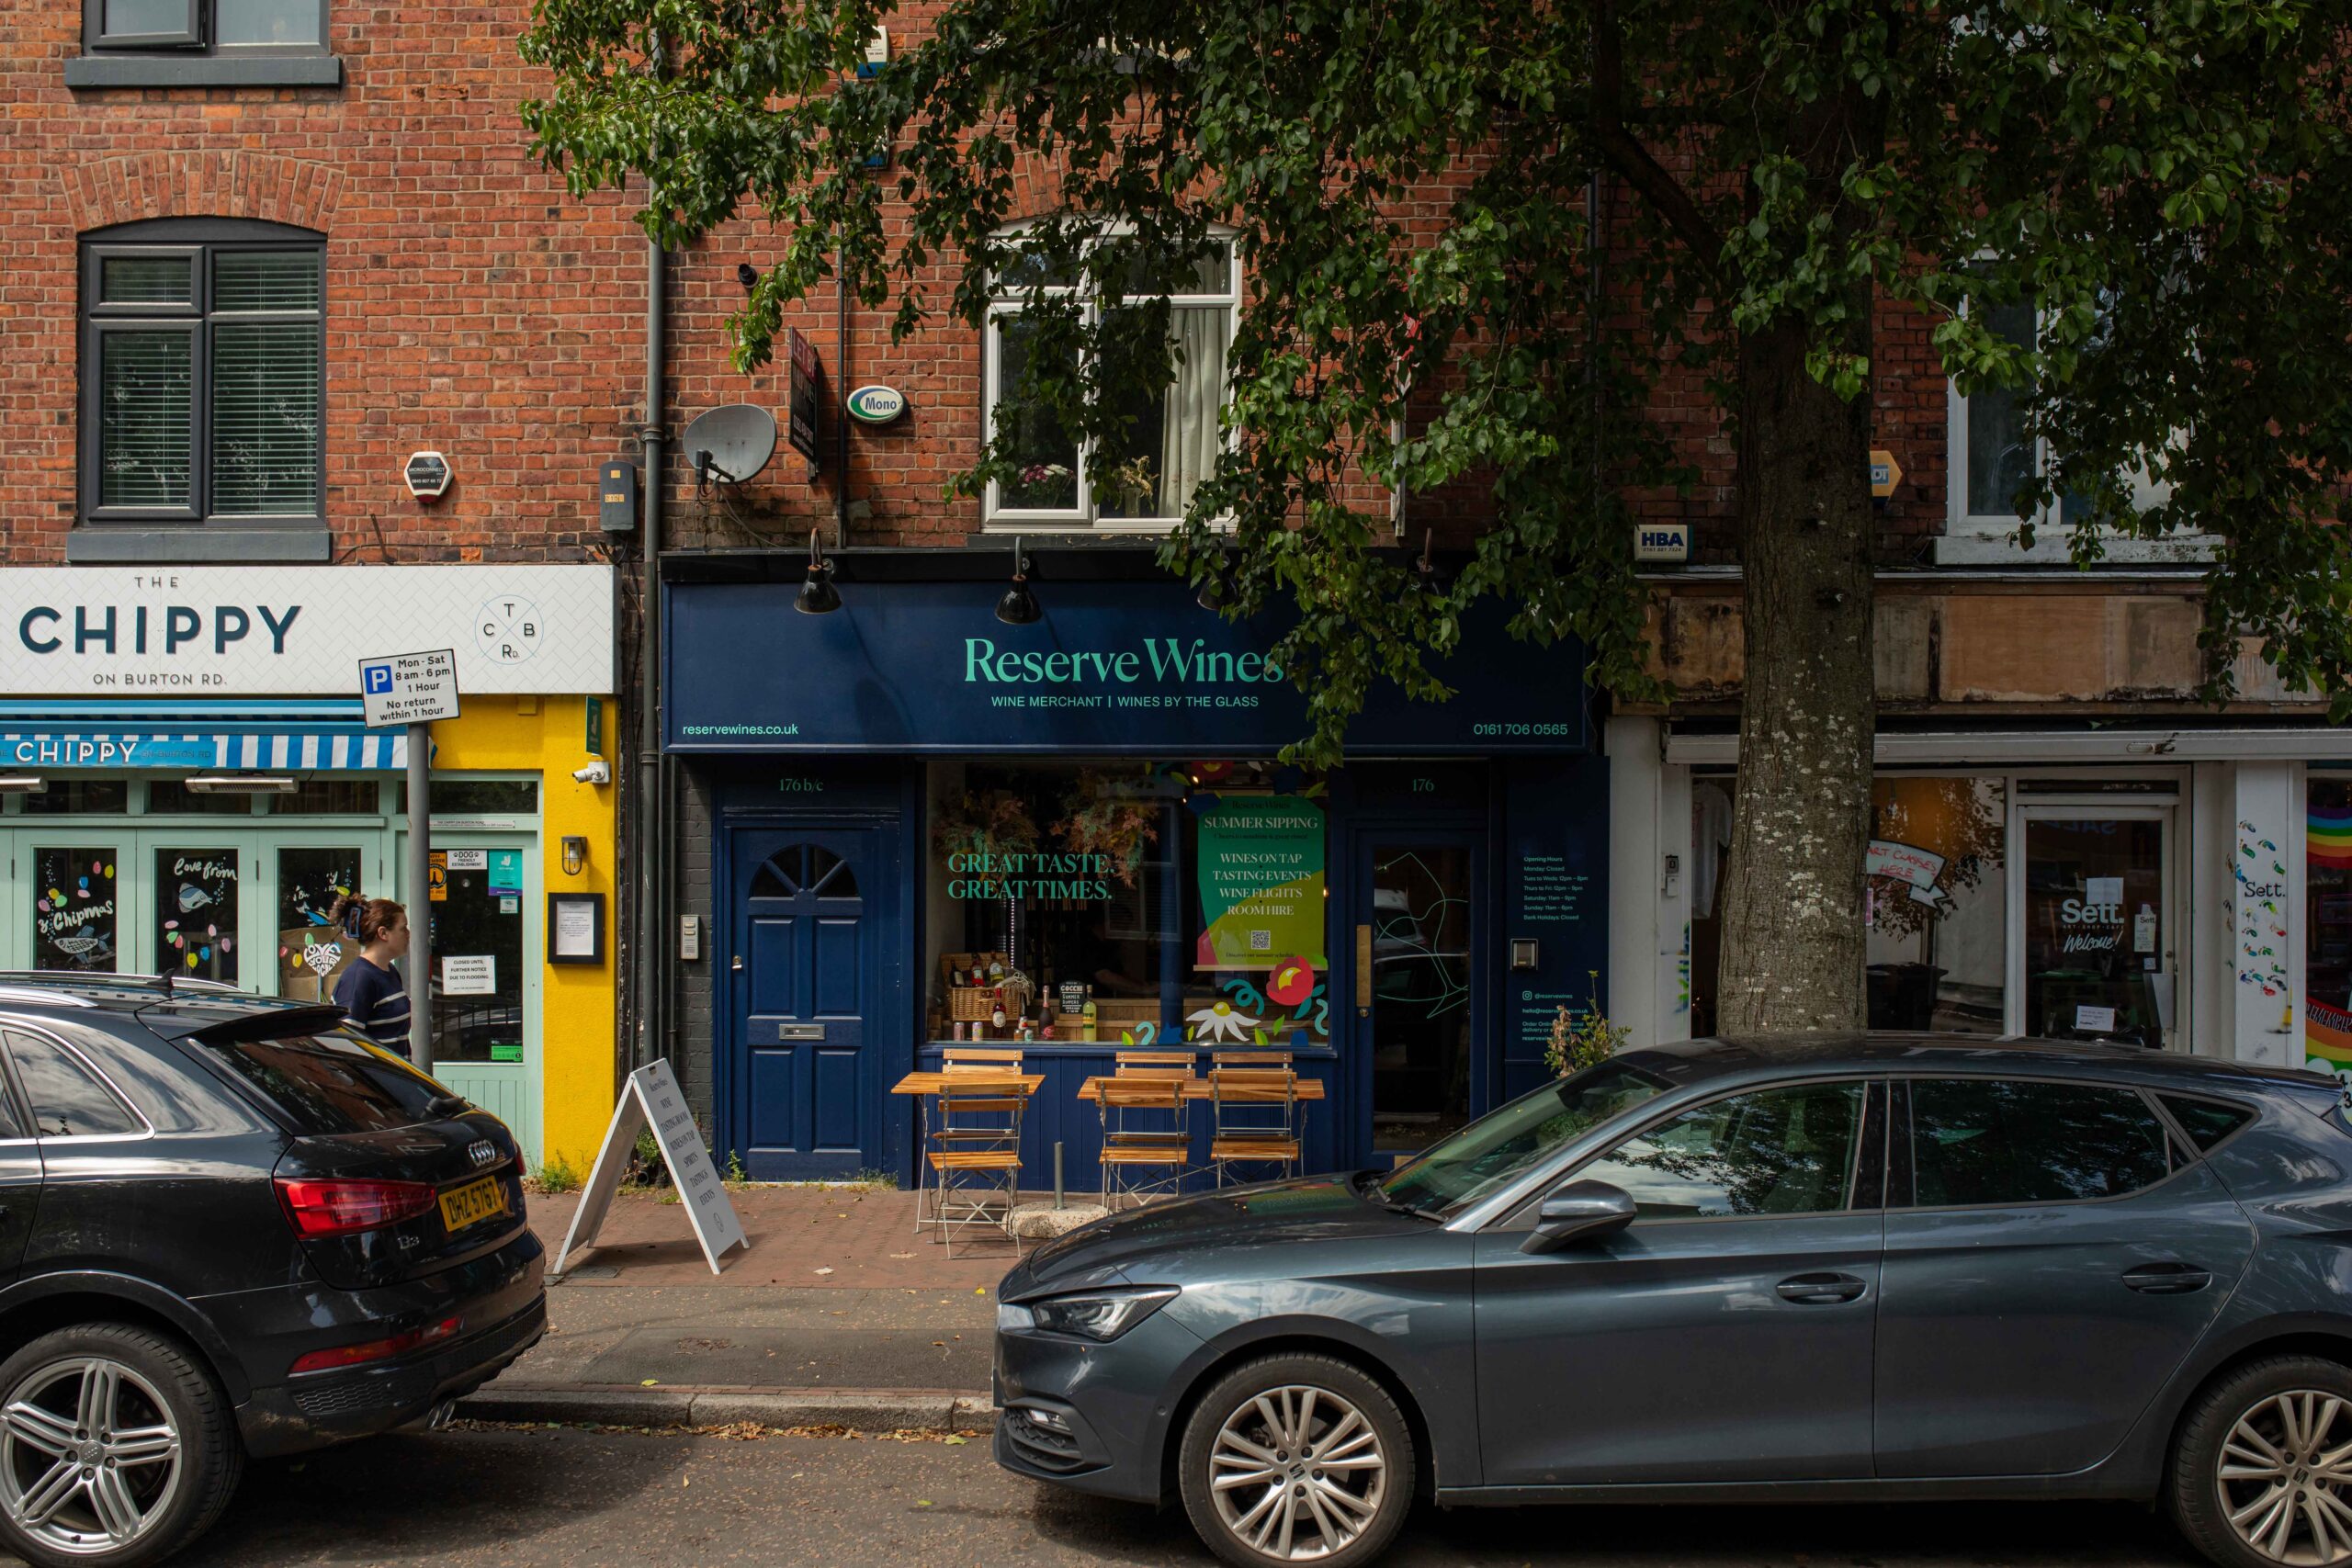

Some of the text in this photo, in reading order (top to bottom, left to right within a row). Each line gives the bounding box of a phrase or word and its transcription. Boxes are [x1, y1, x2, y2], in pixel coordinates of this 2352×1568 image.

[793, 332, 806, 365] LET
[865, 397, 898, 410] Mono
[1642, 532, 1684, 547] HBA
[134, 576, 179, 589] THE
[19, 605, 302, 654] CHIPPY
[398, 658, 420, 669] Mon
[427, 655, 446, 666] Sat
[965, 638, 1284, 682] Reserve Wines
[93, 673, 227, 685] ON BURTON RD.
[395, 672, 401, 681] 8
[426, 669, 433, 677] 6
[435, 668, 450, 678] pm
[407, 682, 440, 693] 1 Hour
[387, 697, 435, 709] No return
[991, 696, 1025, 707] WINE
[1029, 696, 1102, 707] MERCHANT
[1117, 696, 1160, 707] WINES
[1165, 696, 1182, 707] BY
[1186, 696, 1213, 707] THE
[1216, 696, 1259, 707] GLASS
[379, 710, 411, 721] within
[421, 706, 445, 716] hour
[683, 724, 798, 735] reservewines.co.uk
[1474, 724, 1568, 735] 0161 706 0565
[15, 741, 137, 763] CHIPPY
[780, 779, 824, 793] 176 b/c
[1412, 779, 1435, 792] 176
[1204, 817, 1317, 829] SUMMER SIPPING
[1220, 853, 1302, 863] WINES ON TAP
[1867, 847, 1889, 856] ART
[175, 858, 237, 880] Love from
[948, 853, 1114, 873] GREAT TASTE.
[1880, 863, 1915, 877] HERE
[1213, 871, 1311, 881] TASTING EVENTS
[948, 880, 1113, 899] GREAT TIMES.
[1219, 888, 1303, 898] WINE FLIGHTS
[2245, 882, 2286, 897] Sett.
[52, 899, 114, 931] Chipmas
[1227, 906, 1294, 916] ROOM HIRE
[2061, 898, 2124, 924] Sett.
[2063, 931, 2123, 953] Welcome!
[303, 942, 342, 963] LOVE
[308, 957, 337, 966] YOUR
[311, 964, 336, 977] LOCAL
[684, 1151, 698, 1168] SPIRITS
[689, 1168, 707, 1189] TASTINGS
[446, 1190, 472, 1224] DHZ
[470, 1180, 498, 1214] 5767
[699, 1189, 716, 1206] EVENTS
